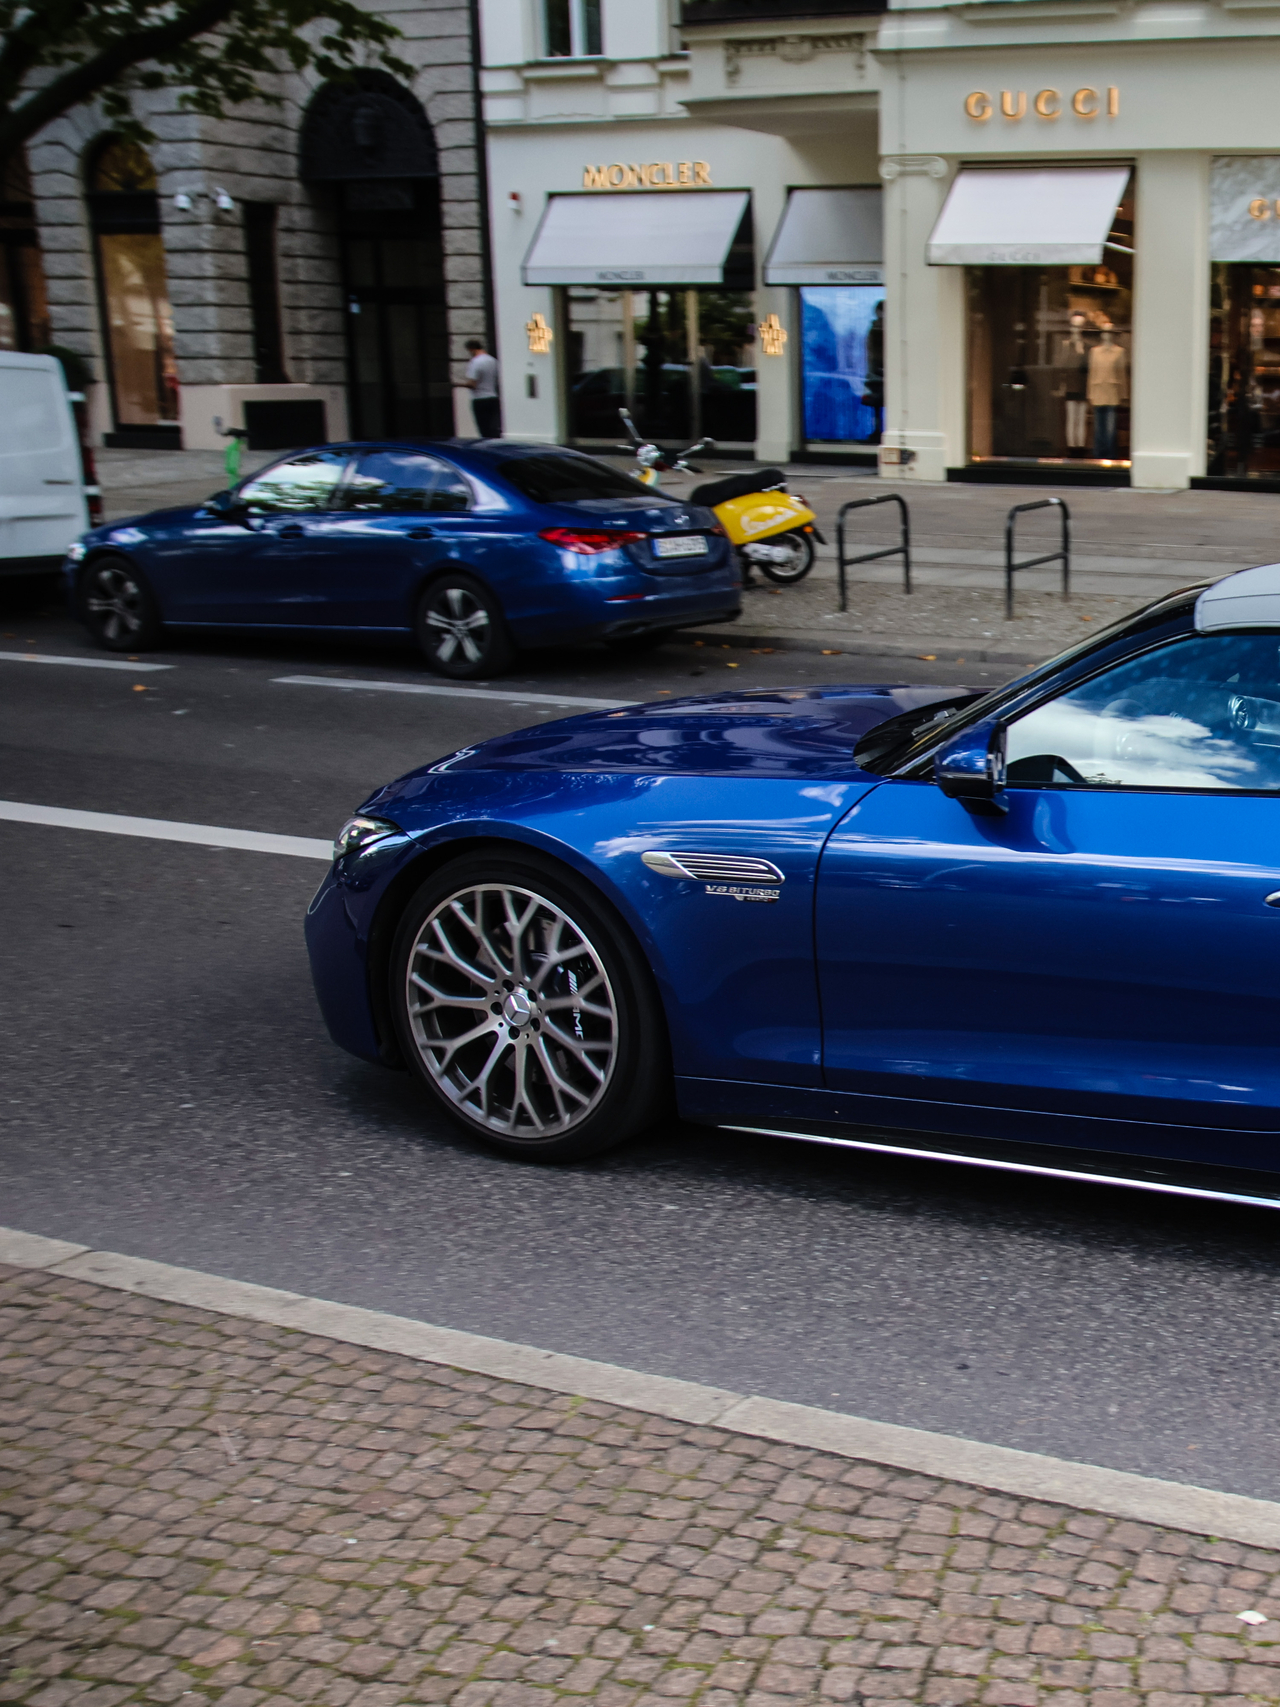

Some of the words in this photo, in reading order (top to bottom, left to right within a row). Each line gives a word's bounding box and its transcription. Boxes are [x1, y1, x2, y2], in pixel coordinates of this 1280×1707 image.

[965, 86, 1120, 120] GUCCI
[584, 161, 713, 188] MONCLER
[705, 885, 727, 893] V8
[729, 886, 780, 897] BITURBO
